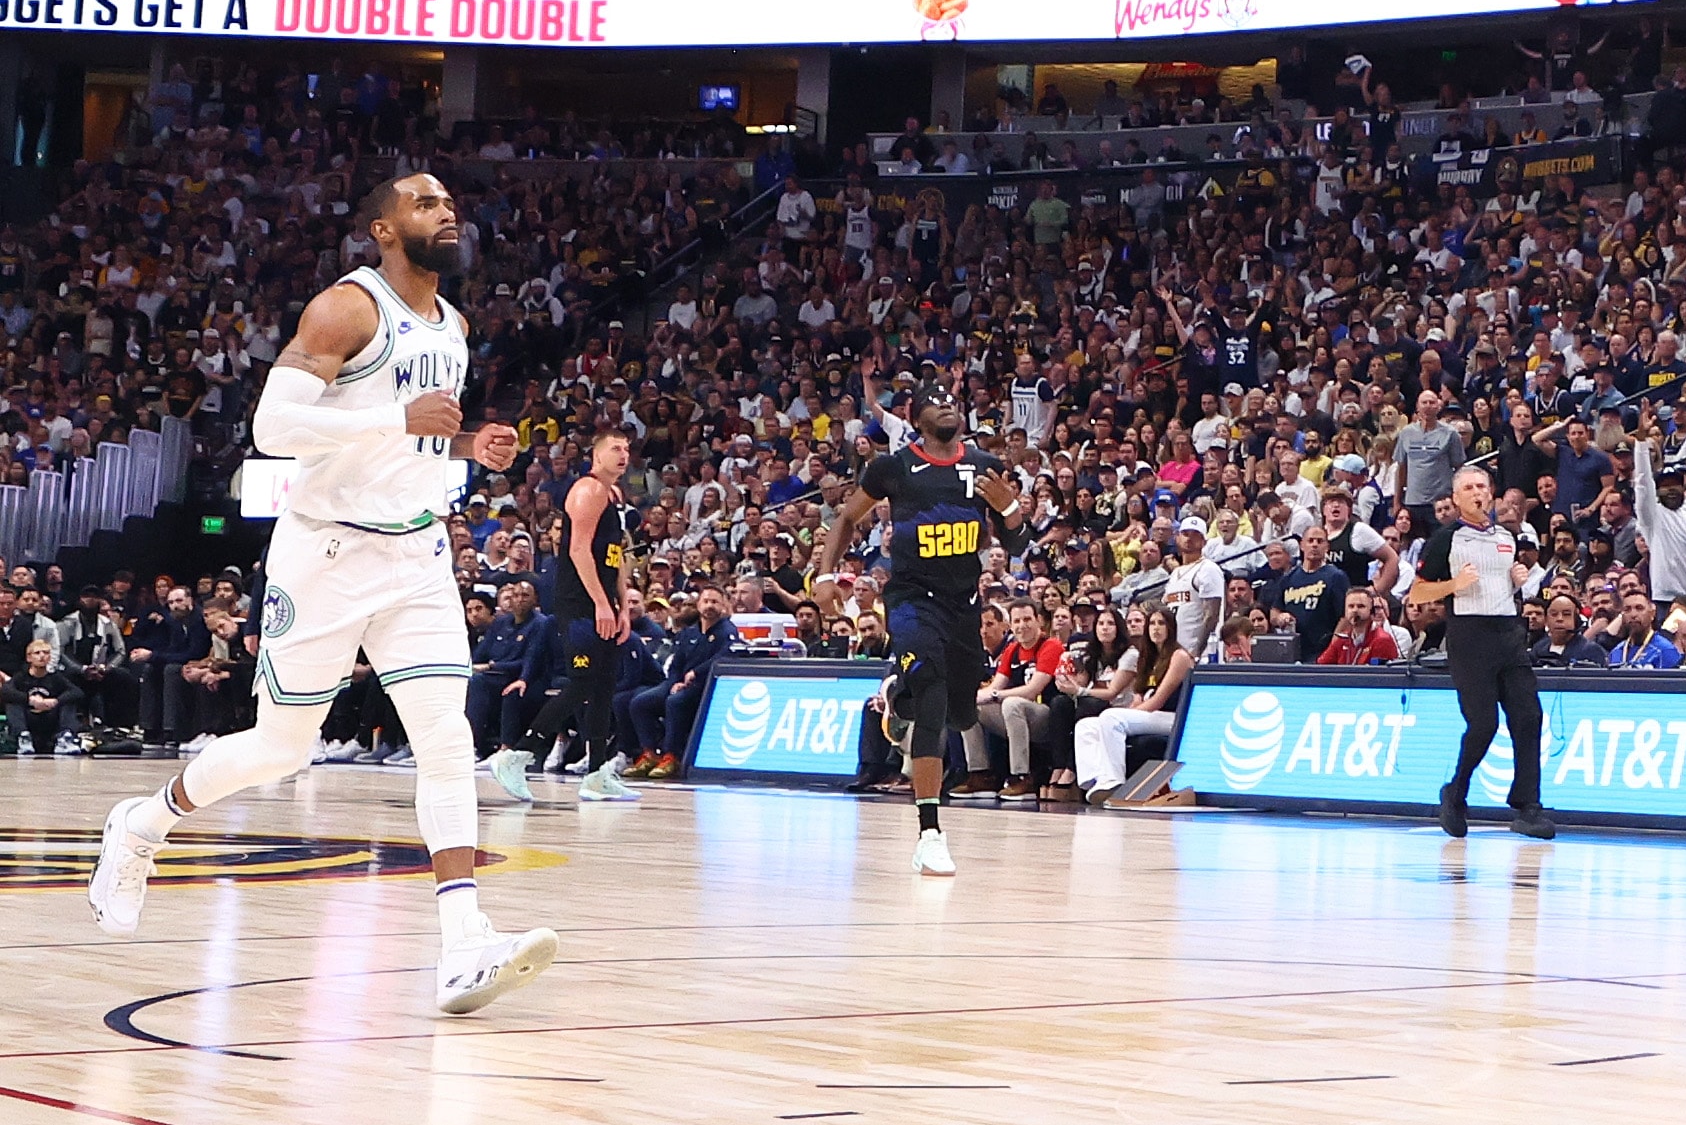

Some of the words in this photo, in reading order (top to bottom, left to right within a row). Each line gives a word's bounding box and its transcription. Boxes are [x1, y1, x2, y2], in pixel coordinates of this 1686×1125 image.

[1228, 351, 1246, 365] 32
[958, 470, 975, 499] 7
[917, 520, 980, 559] 5280
[769, 697, 864, 754] AT&T
[1284, 713, 1416, 777] AT&T
